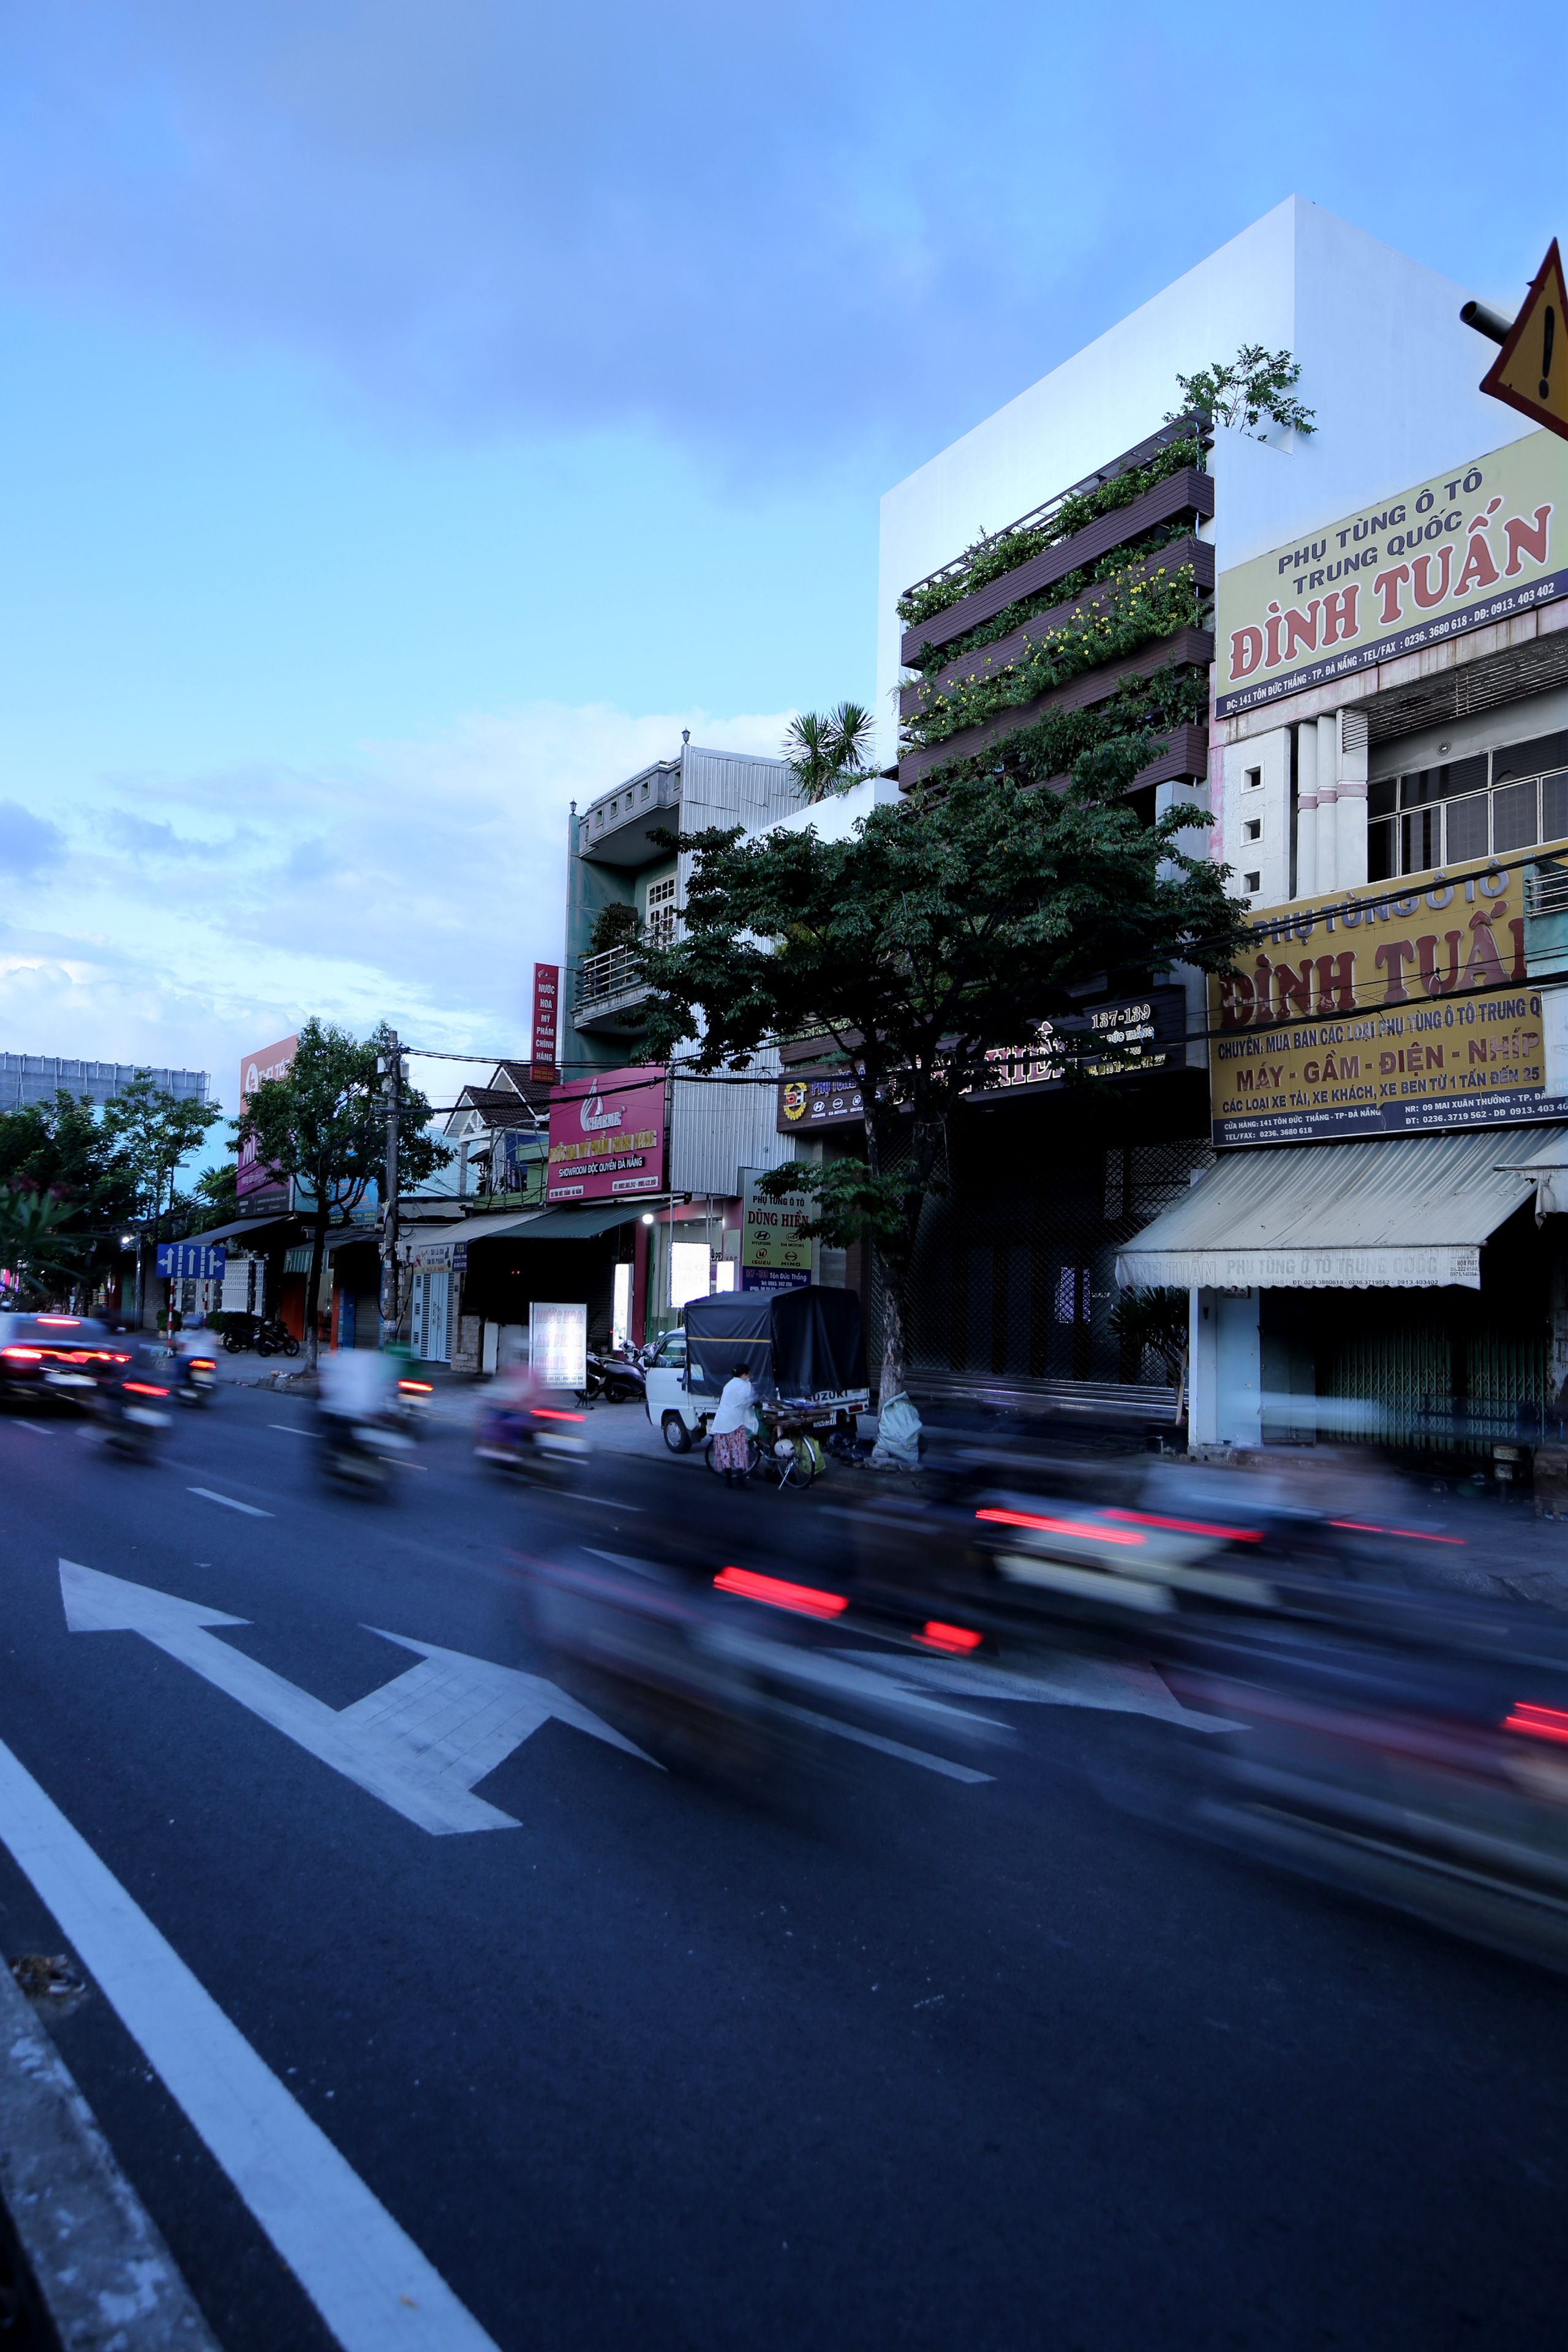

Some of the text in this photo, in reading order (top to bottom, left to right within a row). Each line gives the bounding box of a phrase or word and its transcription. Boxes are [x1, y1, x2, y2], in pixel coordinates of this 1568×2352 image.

[1278, 467, 1483, 574] PHỤ TÙNG Ô TÔ
[1292, 508, 1463, 595] TRUNG QUỐC
[1229, 497, 1552, 682] ĐÌNH TUẤN
[1227, 698, 1238, 710] ĐC:
[1239, 693, 1252, 706] 141
[1253, 688, 1267, 704] TÔN
[1267, 682, 1283, 698] ĐỨC
[1283, 673, 1307, 691] THẮNG
[1312, 667, 1324, 680] TP.
[1325, 663, 1335, 676] ĐÀ
[1336, 654, 1358, 673] NẴNG
[1363, 641, 1396, 662] TEL/FAX
[1404, 631, 1428, 647] 0236.
[1429, 622, 1449, 638] 3680
[1450, 615, 1468, 631] 618
[1490, 598, 1516, 616] 0913.
[1517, 589, 1535, 605] 403
[1536, 582, 1555, 598] 402
[1253, 909, 1316, 948] PHỤ
[1321, 887, 1420, 932] TÙNG
[1425, 872, 1455, 910] Ô
[1219, 900, 1528, 1028] ĐÌNH TUẤ
[538, 983, 556, 995] NƯỚC
[540, 998, 553, 1009] HOA
[541, 1014, 551, 1023] MỸ
[1091, 1003, 1151, 1030] 137-139
[1266, 1033, 1291, 1053] MUA
[1294, 1027, 1317, 1050] BÁN
[1320, 1023, 1344, 1046] CÁC
[1348, 1020, 1375, 1042] LOẠI
[1379, 1017, 1404, 1038] PHỤ
[1407, 1009, 1442, 1033] TÙNG
[1445, 1005, 1455, 1028] Ô
[1457, 1001, 1476, 1025] TÔ
[1479, 998, 1526, 1022] TRUNG
[536, 1025, 554, 1036] PHẨM
[535, 1038, 554, 1049] CHÍNH
[536, 1051, 552, 1061] HÃNG
[1237, 1026, 1540, 1091] MÁY GẦM ĐIỆN NHÍP
[1223, 1097, 1243, 1113] CÁC
[1246, 1096, 1270, 1112] LOẠI
[1272, 1095, 1287, 1107] XE
[1313, 1090, 1329, 1104] XE
[1331, 1084, 1378, 1101] KHÁCH,
[1379, 1082, 1398, 1096] XE
[1401, 1079, 1427, 1094] BEN
[1430, 1074, 1448, 1090] TỪ
[1450, 1076, 1457, 1088] 1
[1460, 1068, 1487, 1088] TẤN
[1490, 1065, 1519, 1085] ĐẾN
[1523, 1066, 1540, 1082] 25
[1422, 1103, 1433, 1112] 09
[1434, 1101, 1450, 1110] MAI
[1451, 1098, 1475, 1109] XUÂN
[1476, 1093, 1511, 1107] THƯỞNG
[1517, 1094, 1532, 1102] TP.
[1470, 1110, 1487, 1120] 562
[1509, 1106, 1536, 1115] 0913.
[1537, 1104, 1555, 1113] 403
[1224, 1120, 1238, 1130] CỬA
[1238, 1119, 1259, 1129] HÀNG:
[1273, 1117, 1287, 1126] TÔN
[1289, 1114, 1303, 1124] ĐỨC
[1305, 1112, 1330, 1123] THẮNG
[1360, 1107, 1382, 1117] NẴNG
[1224, 1132, 1256, 1141] TEL/FAX:
[1259, 1129, 1280, 1138] 0236.
[1280, 1128, 1298, 1137] 3680
[558, 1165, 587, 1178] SHOWROOM
[587, 1162, 598, 1175] ĐỘC
[599, 1158, 617, 1172] QUYỀN
[617, 1158, 626, 1169] ĐÀ
[753, 1195, 805, 1207] PHỤ Ô TÔ
[781, 1209, 809, 1227] HIỀN
[1166, 1253, 1216, 1285] TUẤN
[1260, 1256, 1295, 1275] TÙNG
[1299, 1256, 1310, 1274] Ô
[1314, 1254, 1332, 1274] TÔ
[791, 1272, 807, 1283] Thắng
[562, 1310, 583, 1324] HOA
